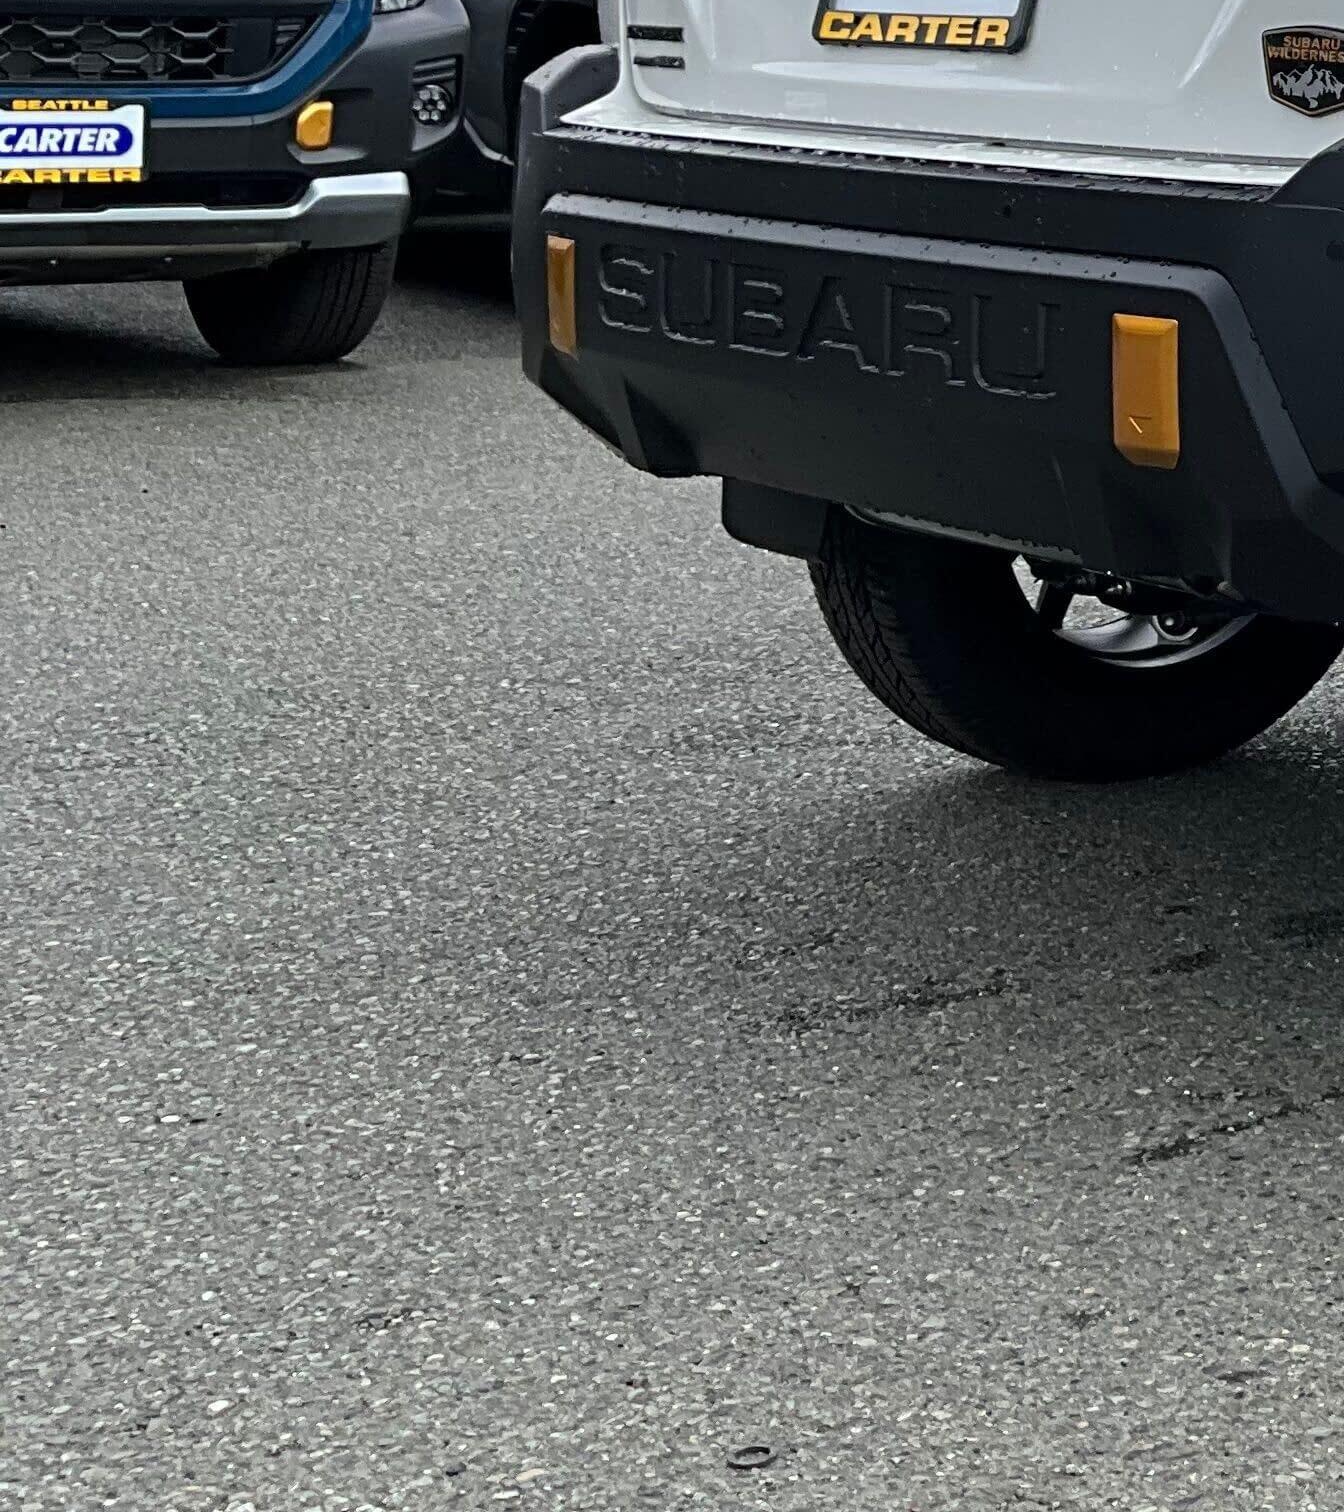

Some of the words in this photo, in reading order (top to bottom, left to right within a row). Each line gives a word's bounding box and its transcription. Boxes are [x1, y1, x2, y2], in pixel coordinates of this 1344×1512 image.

[818, 10, 1011, 48] CARTER
[1283, 36, 1341, 50] SUBARU
[12, 99, 109, 111] SEATTLE
[0, 127, 121, 154] CARTER
[0, 168, 142, 183] ARTER
[597, 243, 1060, 400] SUBARU
